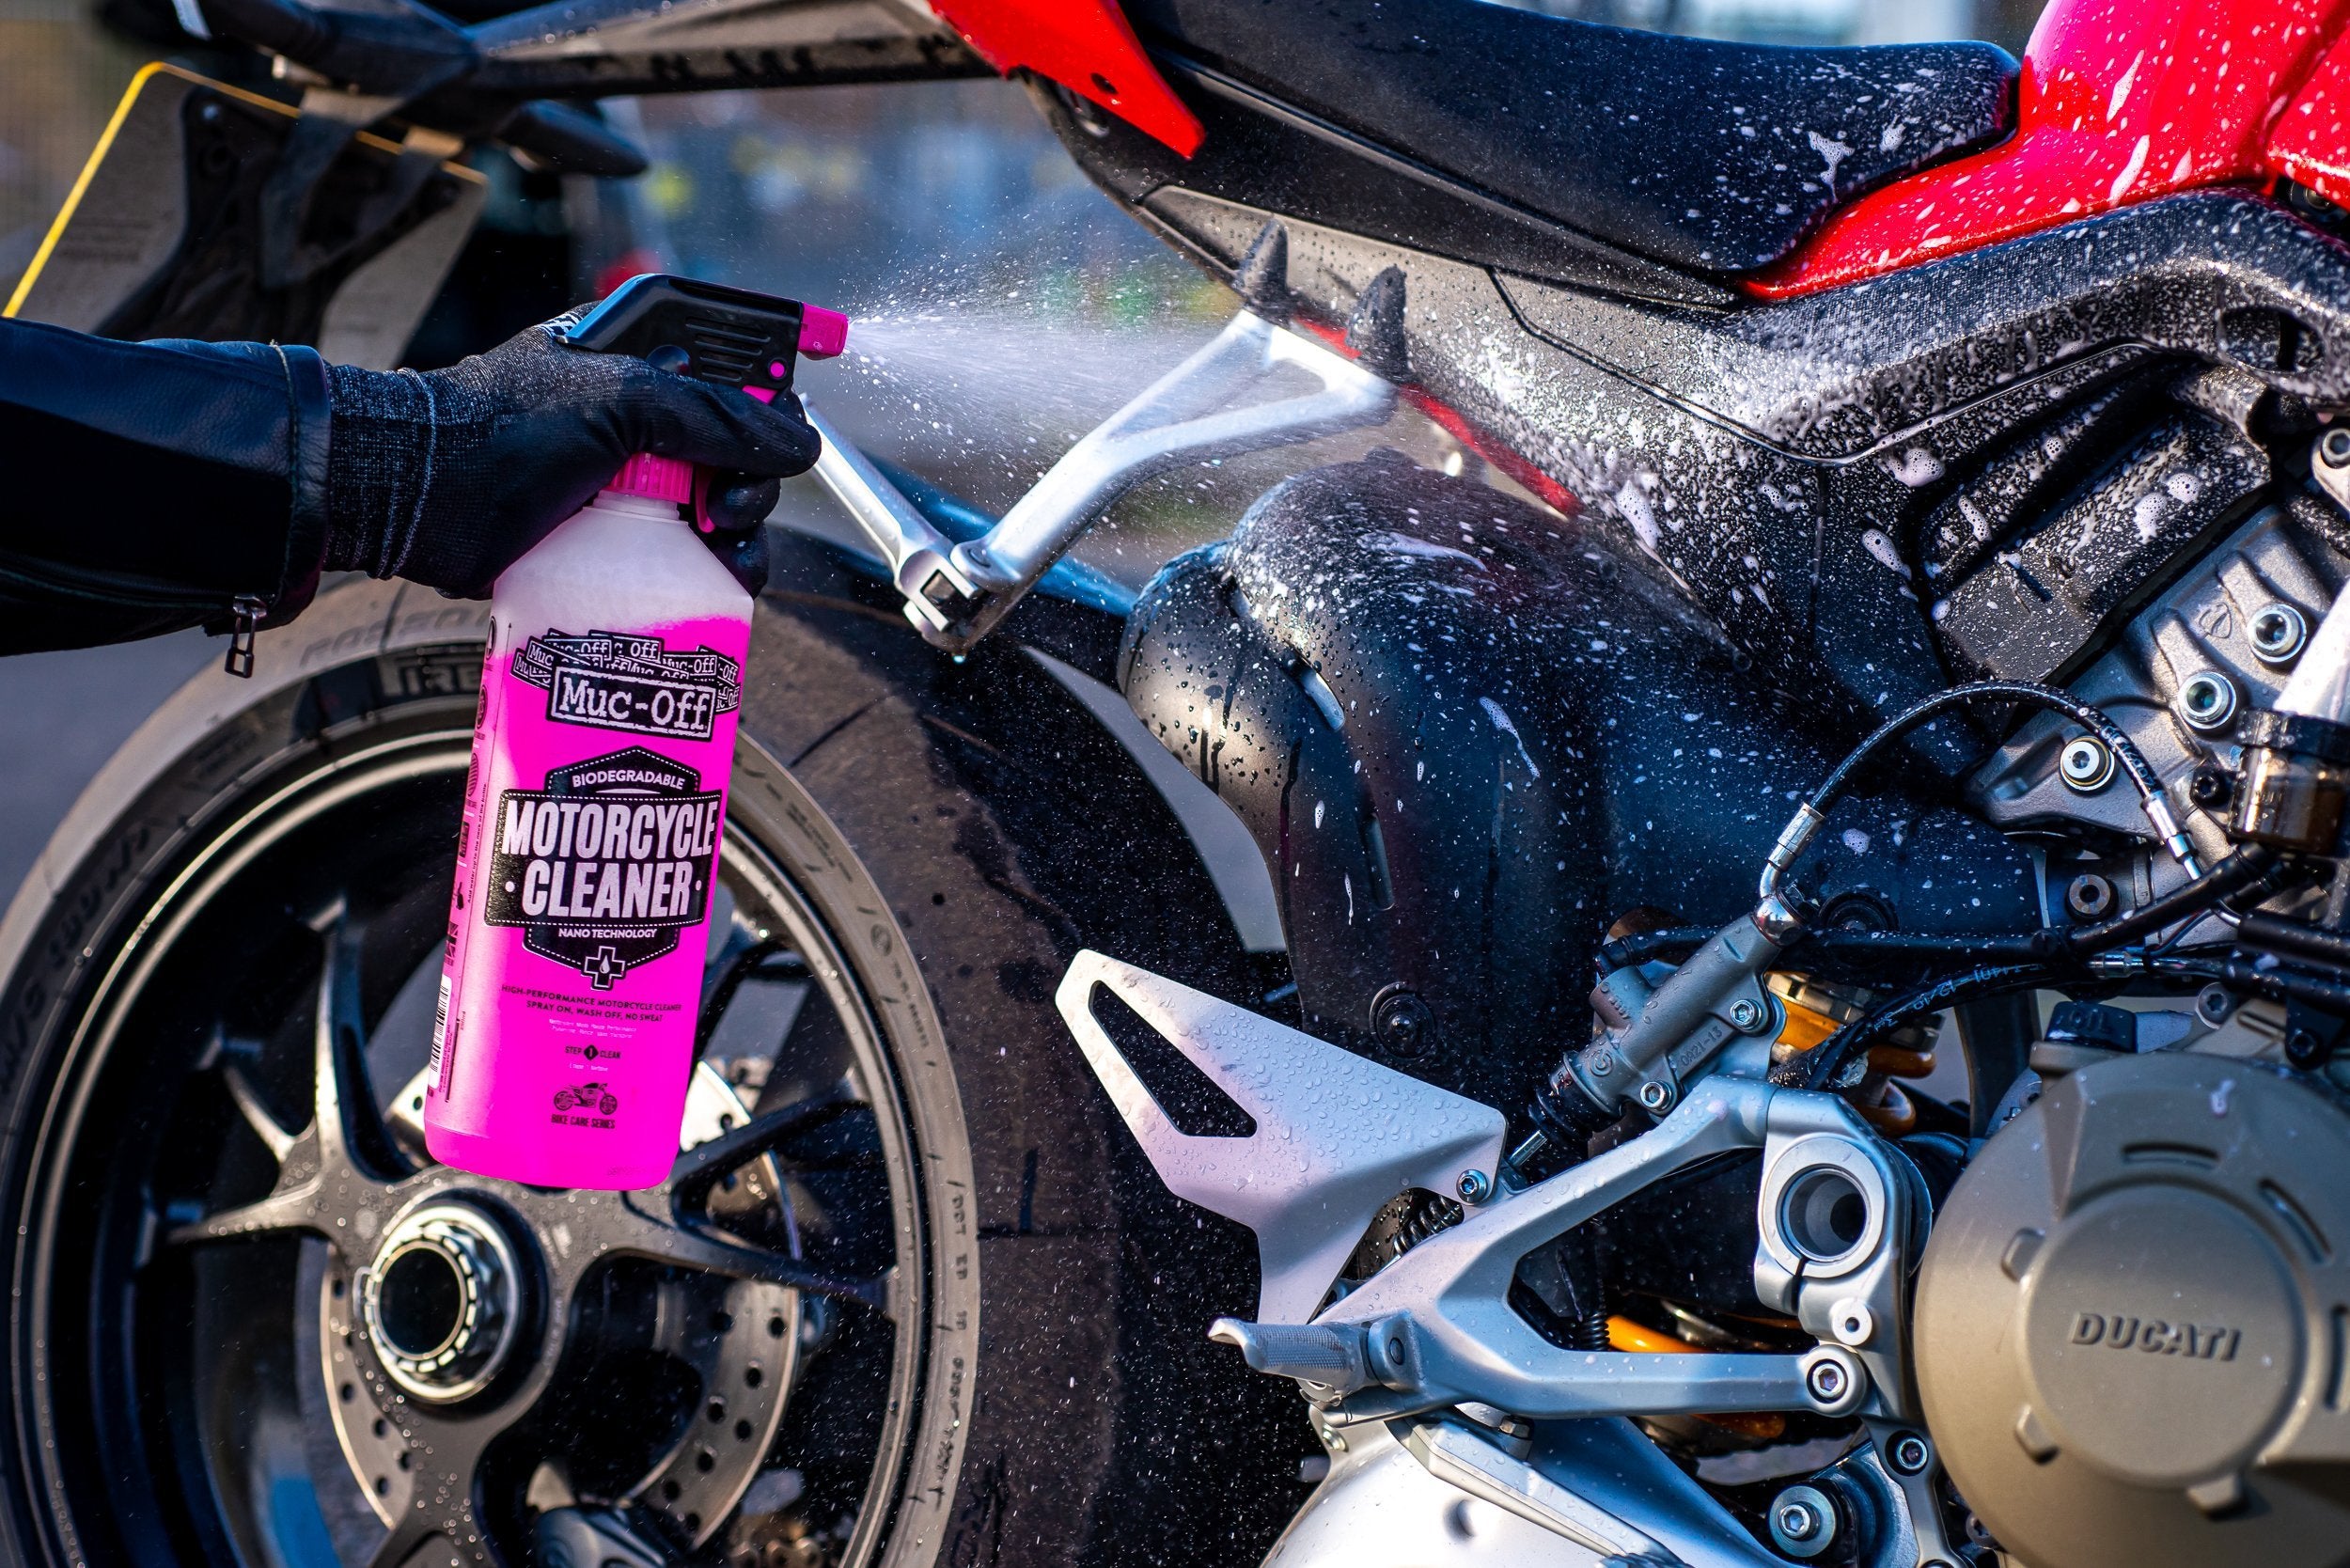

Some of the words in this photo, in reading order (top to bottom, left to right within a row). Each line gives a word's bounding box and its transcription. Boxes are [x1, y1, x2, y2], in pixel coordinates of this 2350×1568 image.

[558, 675, 712, 731] Muc-Off
[572, 769, 685, 791] BIODEGRADABLE
[501, 799, 719, 860] MOTORCYCLE
[521, 859, 694, 919] CLEANER
[557, 928, 591, 938] NANO
[591, 928, 658, 939] TECHNOLOGY
[501, 984, 595, 1006] HIGH-PERFORMANCE
[597, 999, 653, 1011] MOTORCYCLE
[654, 1003, 682, 1012] CLEANER
[525, 999, 555, 1012] SPRAY
[556, 1005, 574, 1015] ON,
[576, 1007, 603, 1018] WASH
[604, 1011, 623, 1021] OFF,
[625, 1012, 638, 1022] NO
[639, 1013, 664, 1023] SWEAT
[565, 1045, 582, 1056] STEP
[600, 1050, 621, 1059] CLEAN
[551, 1114, 568, 1125] BIKE
[570, 1116, 590, 1127] CARE
[591, 1118, 617, 1130] SERIES
[2070, 1312, 2243, 1362] DUCATI
